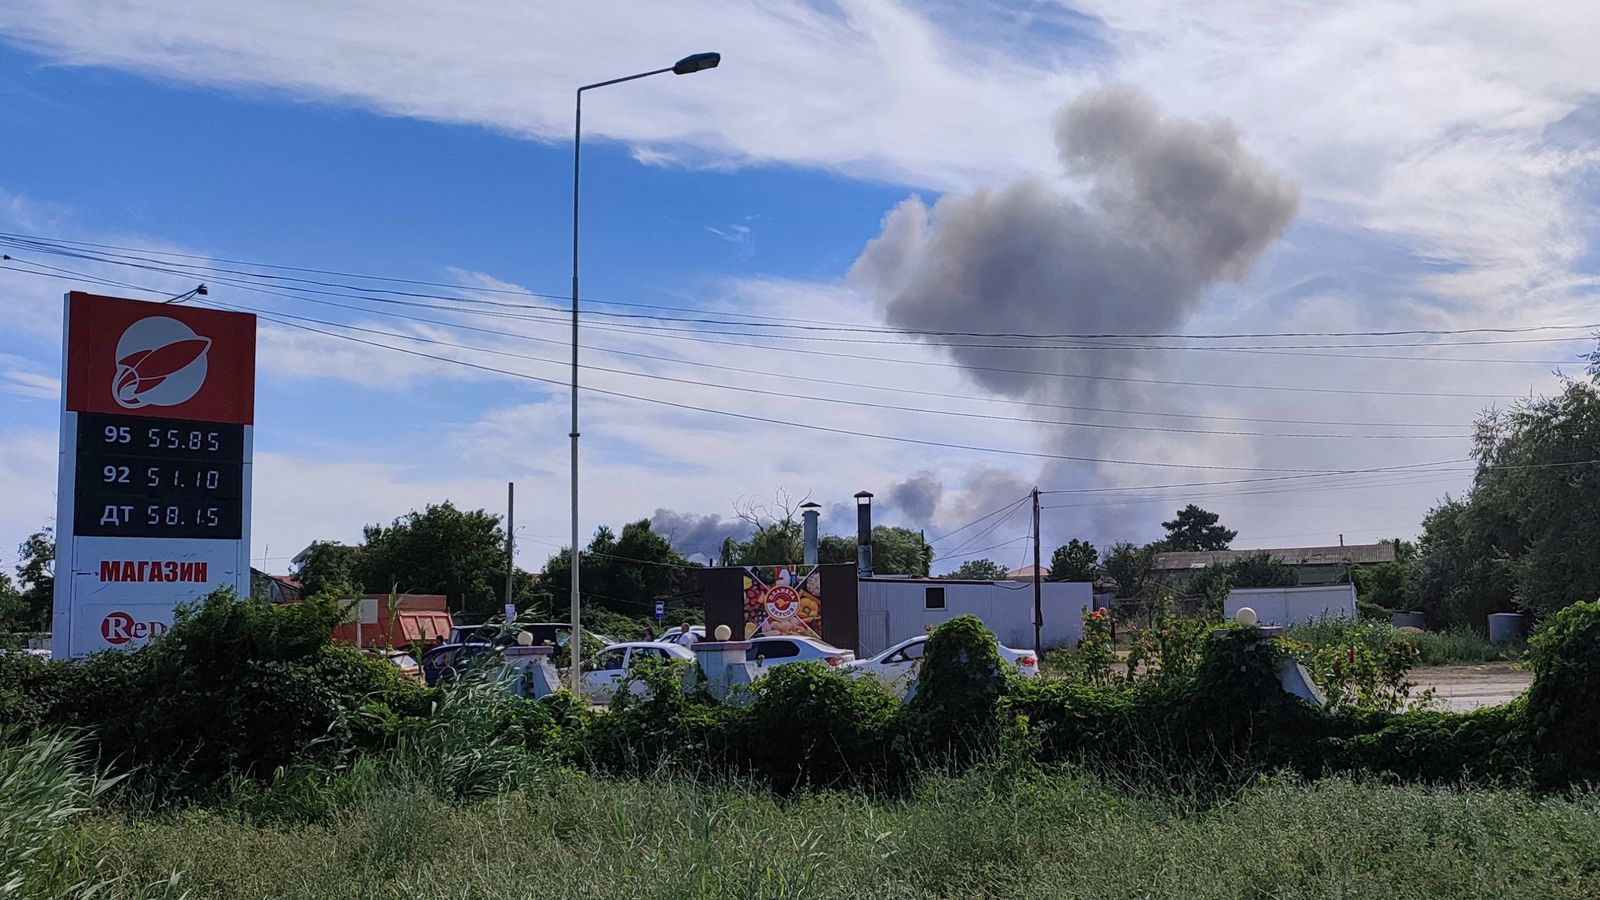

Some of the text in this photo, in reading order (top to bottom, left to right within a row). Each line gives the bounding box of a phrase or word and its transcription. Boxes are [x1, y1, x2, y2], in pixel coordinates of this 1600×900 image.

[104, 425, 219, 451] 95 55.85
[103, 465, 219, 489] 92 51.10
[100, 505, 134, 526] ДТ
[100, 560, 208, 583] МАГАЗИН
